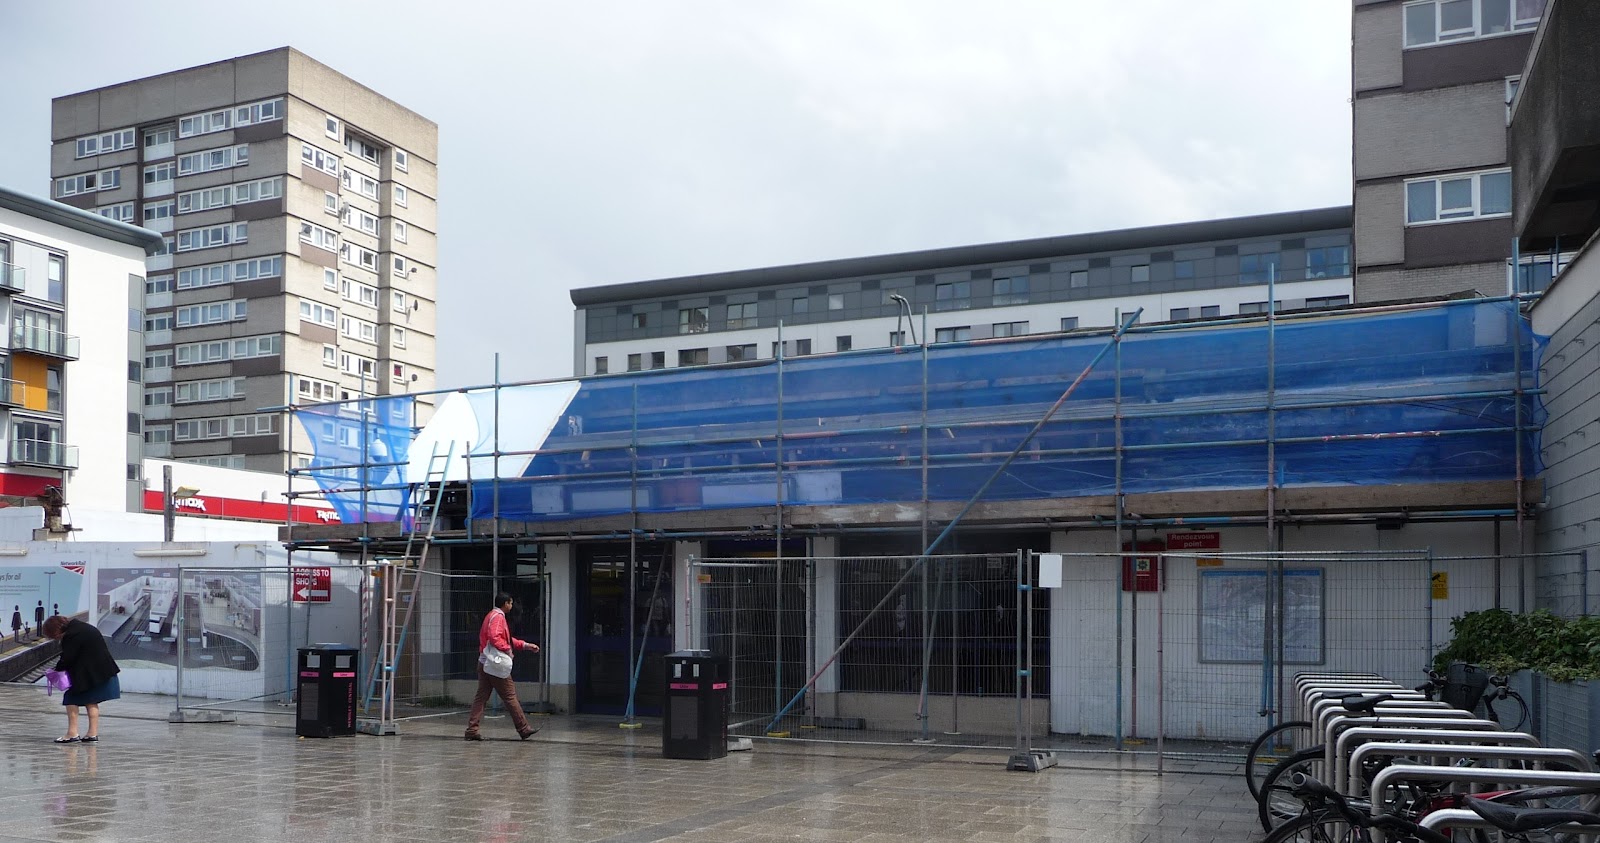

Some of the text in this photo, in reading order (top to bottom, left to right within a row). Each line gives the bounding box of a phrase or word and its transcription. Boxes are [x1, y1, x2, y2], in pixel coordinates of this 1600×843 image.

[1171, 533, 1215, 541] Rendezvous
[6, 572, 14, 582] for
[295, 568, 330, 577] ACCSS TO
[295, 577, 318, 586] SHOS
